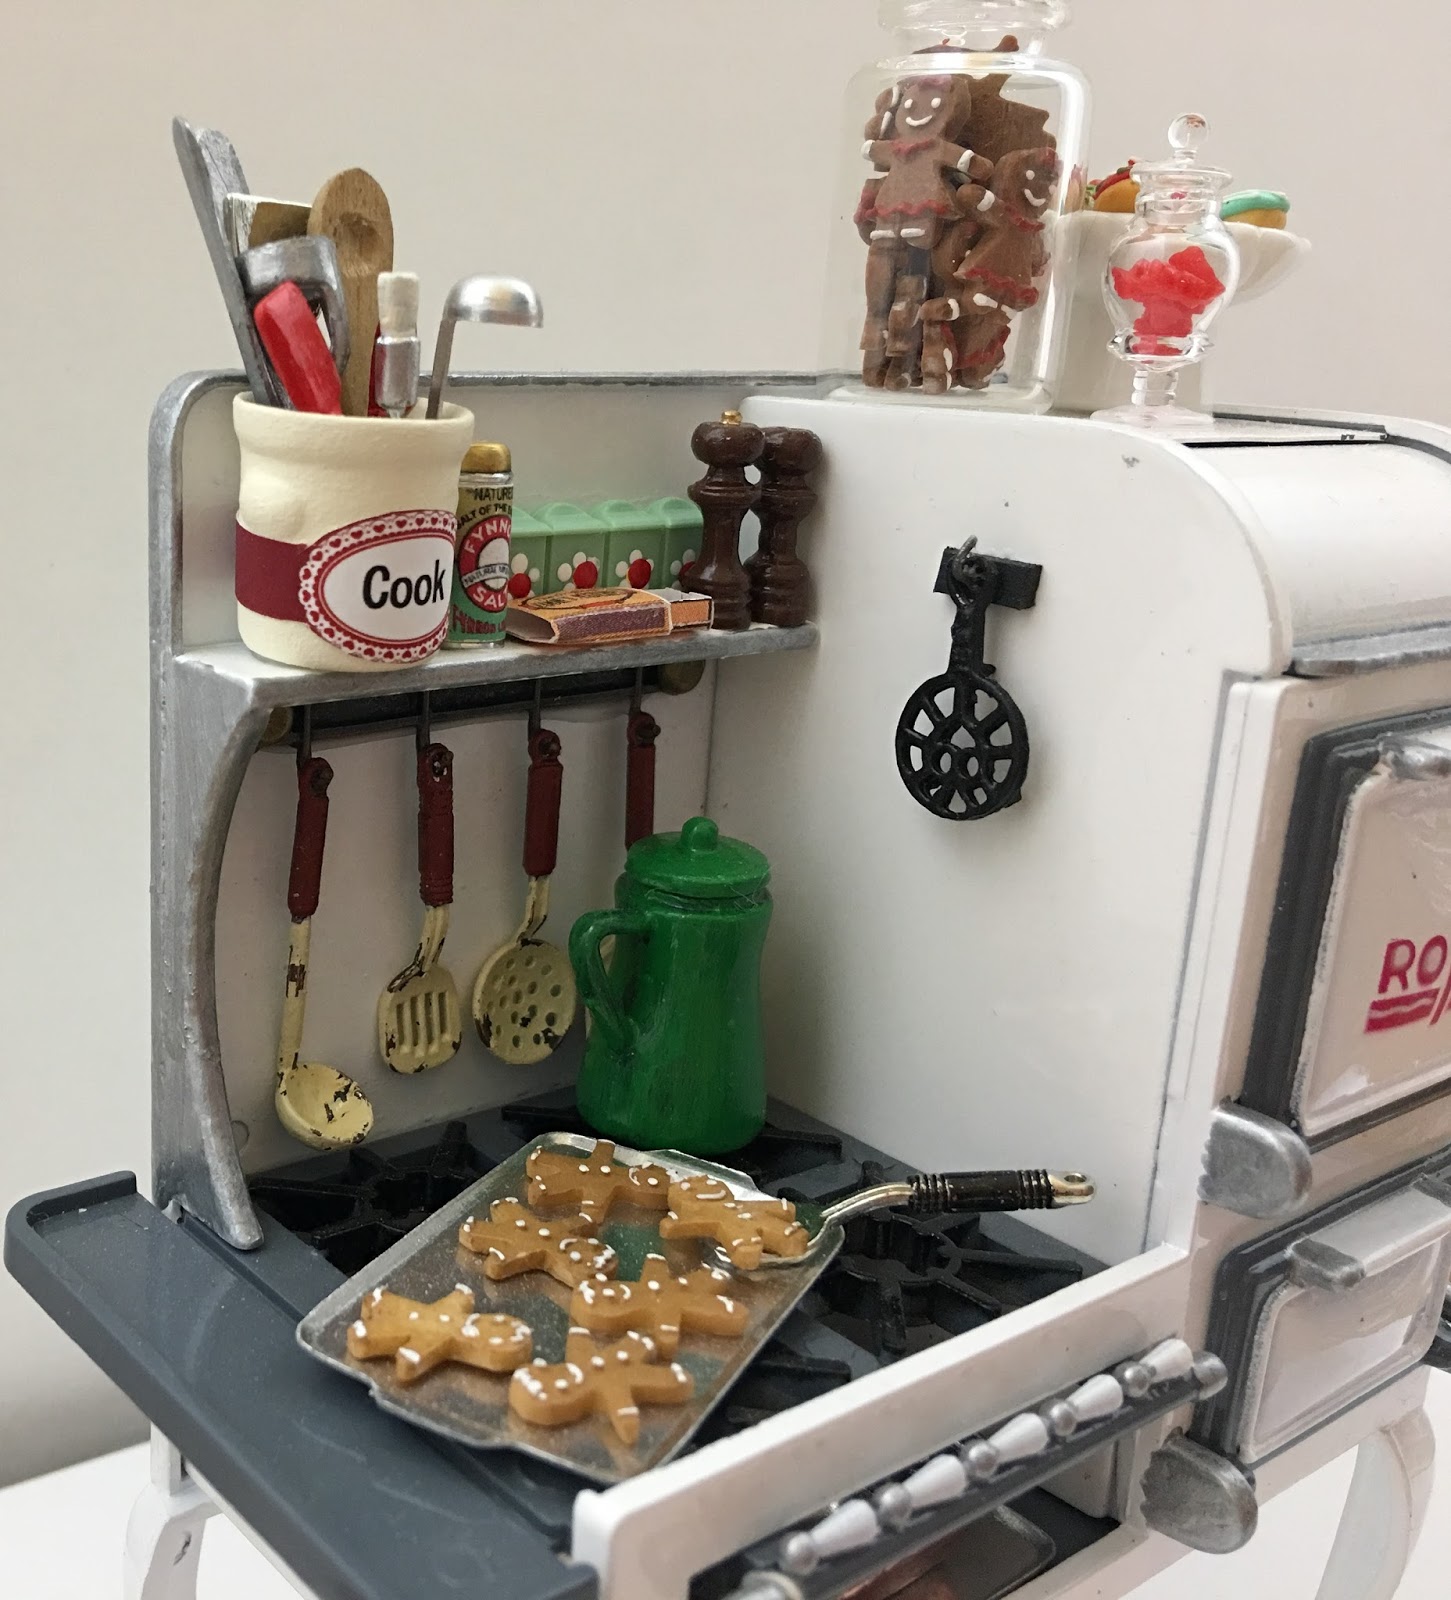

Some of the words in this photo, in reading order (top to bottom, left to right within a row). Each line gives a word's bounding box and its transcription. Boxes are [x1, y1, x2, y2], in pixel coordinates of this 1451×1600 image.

[478, 504, 492, 516] OF
[494, 503, 508, 513] THE
[362, 559, 446, 609] Cook
[472, 584, 508, 609] SAL
[1377, 935, 1451, 1026] RO
